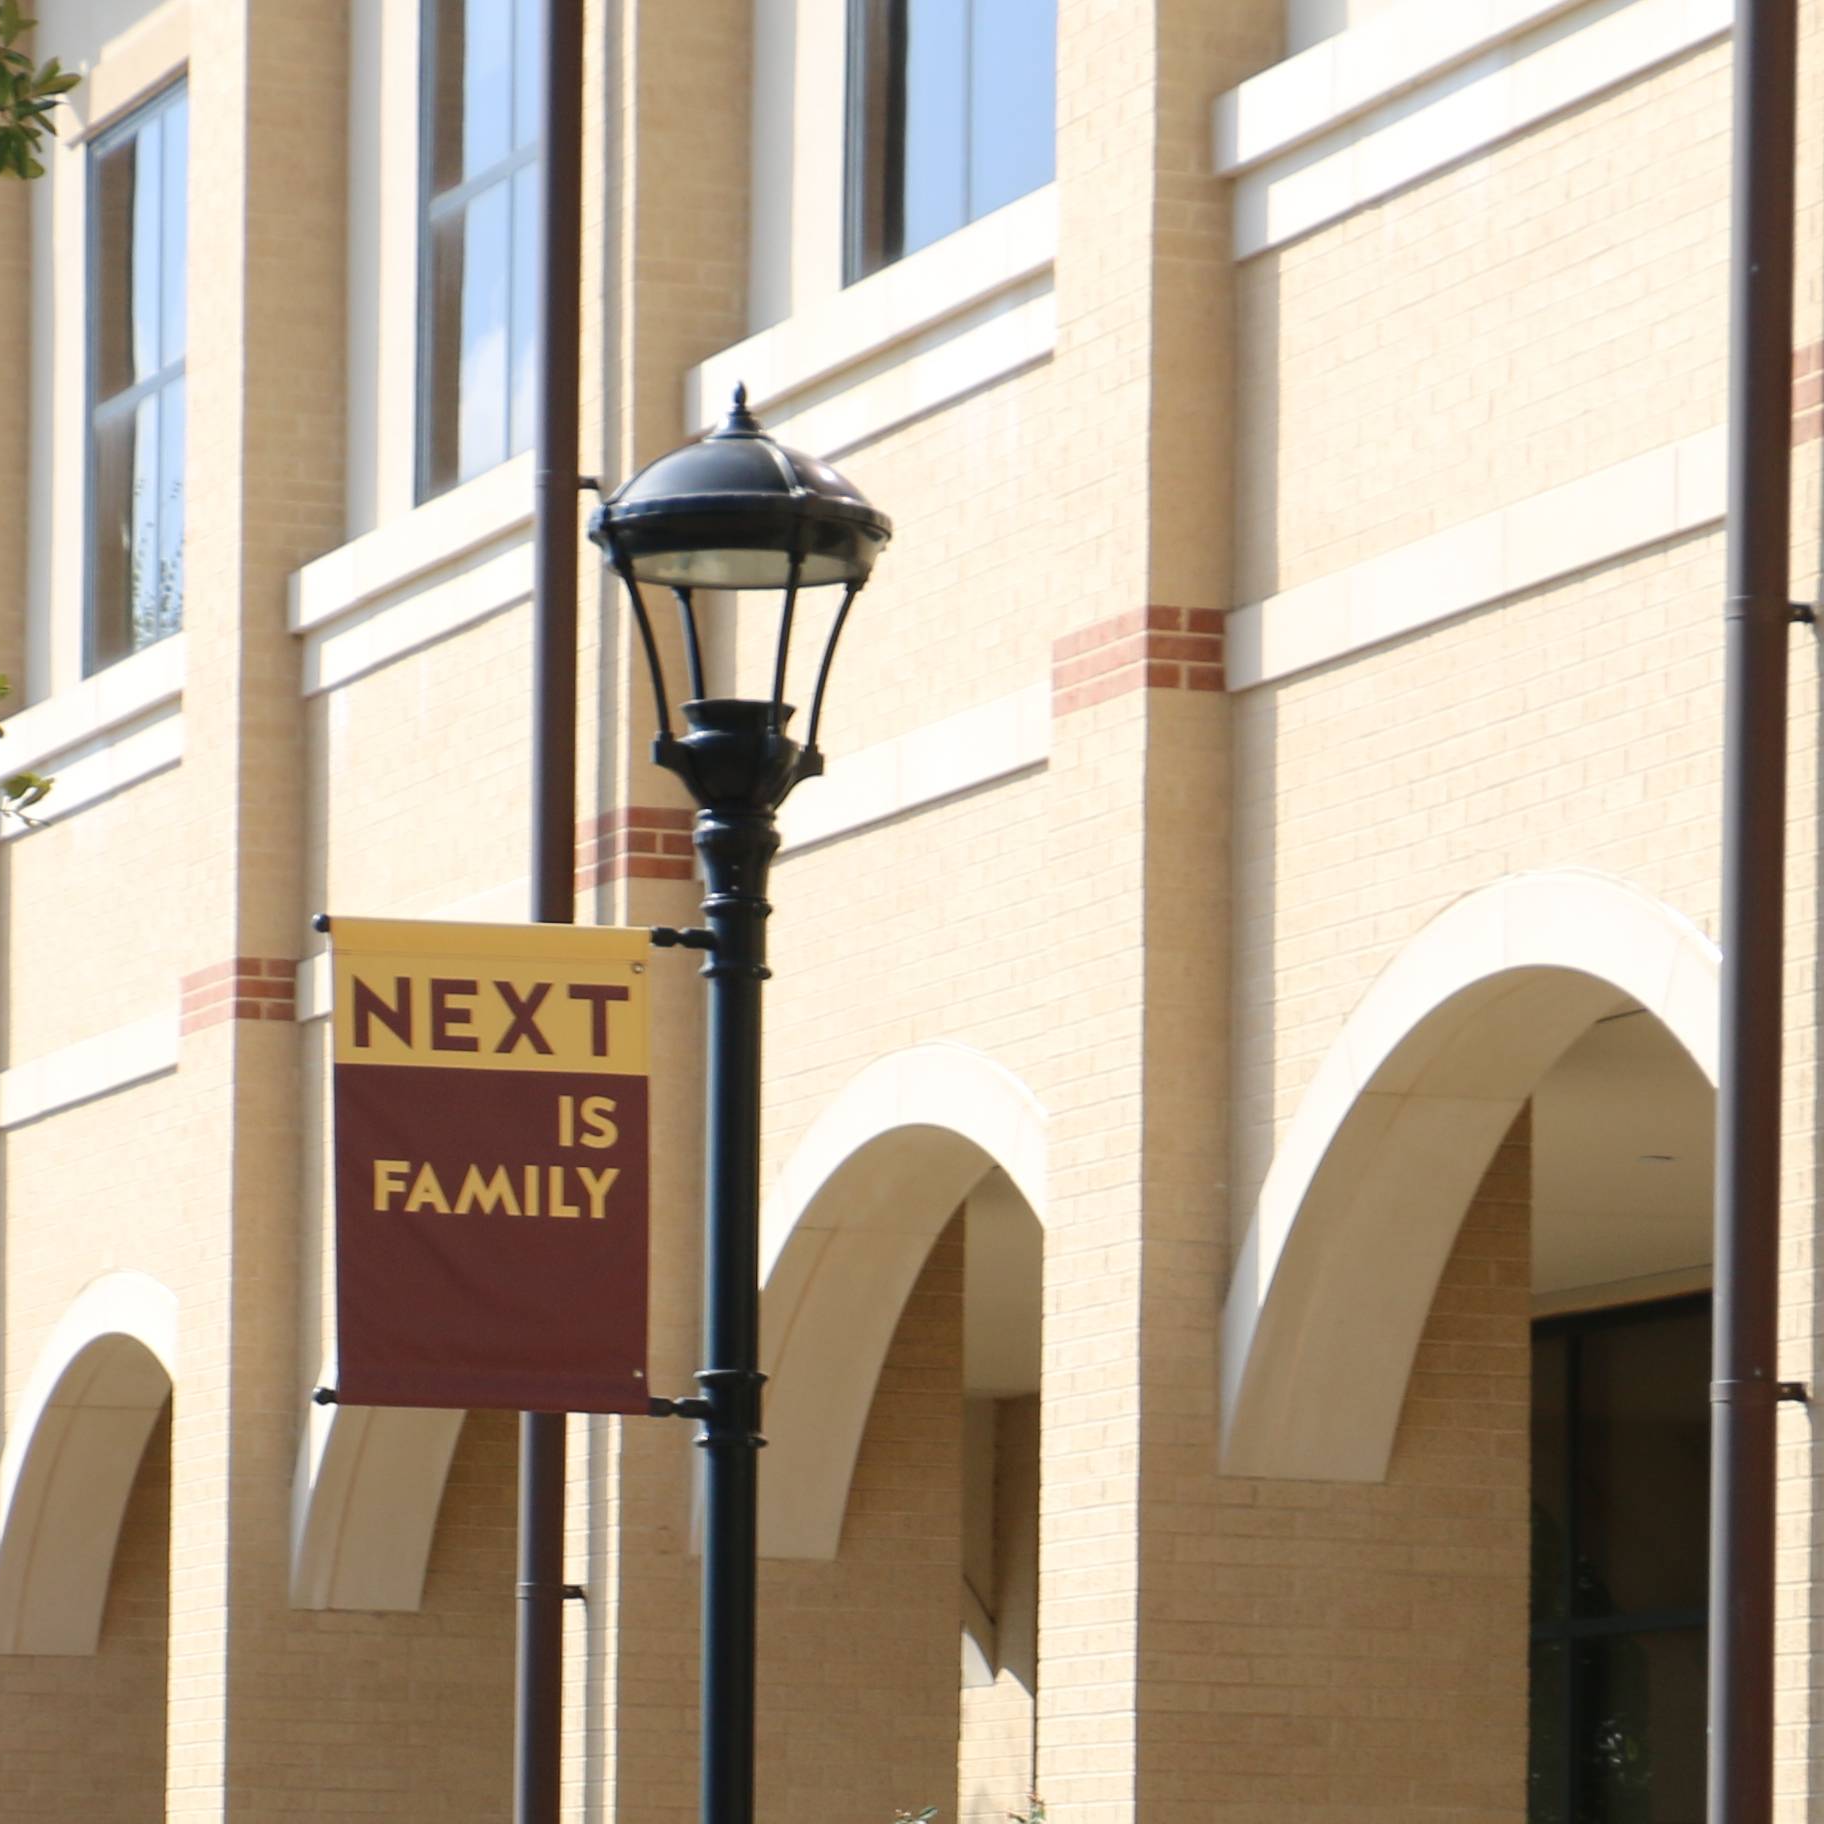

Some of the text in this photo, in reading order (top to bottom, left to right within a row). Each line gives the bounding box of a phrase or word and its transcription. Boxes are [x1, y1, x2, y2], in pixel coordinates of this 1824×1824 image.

[352, 974, 630, 1057] NEXT
[558, 1095, 619, 1149] IS
[372, 1159, 621, 1219] FAMILY
